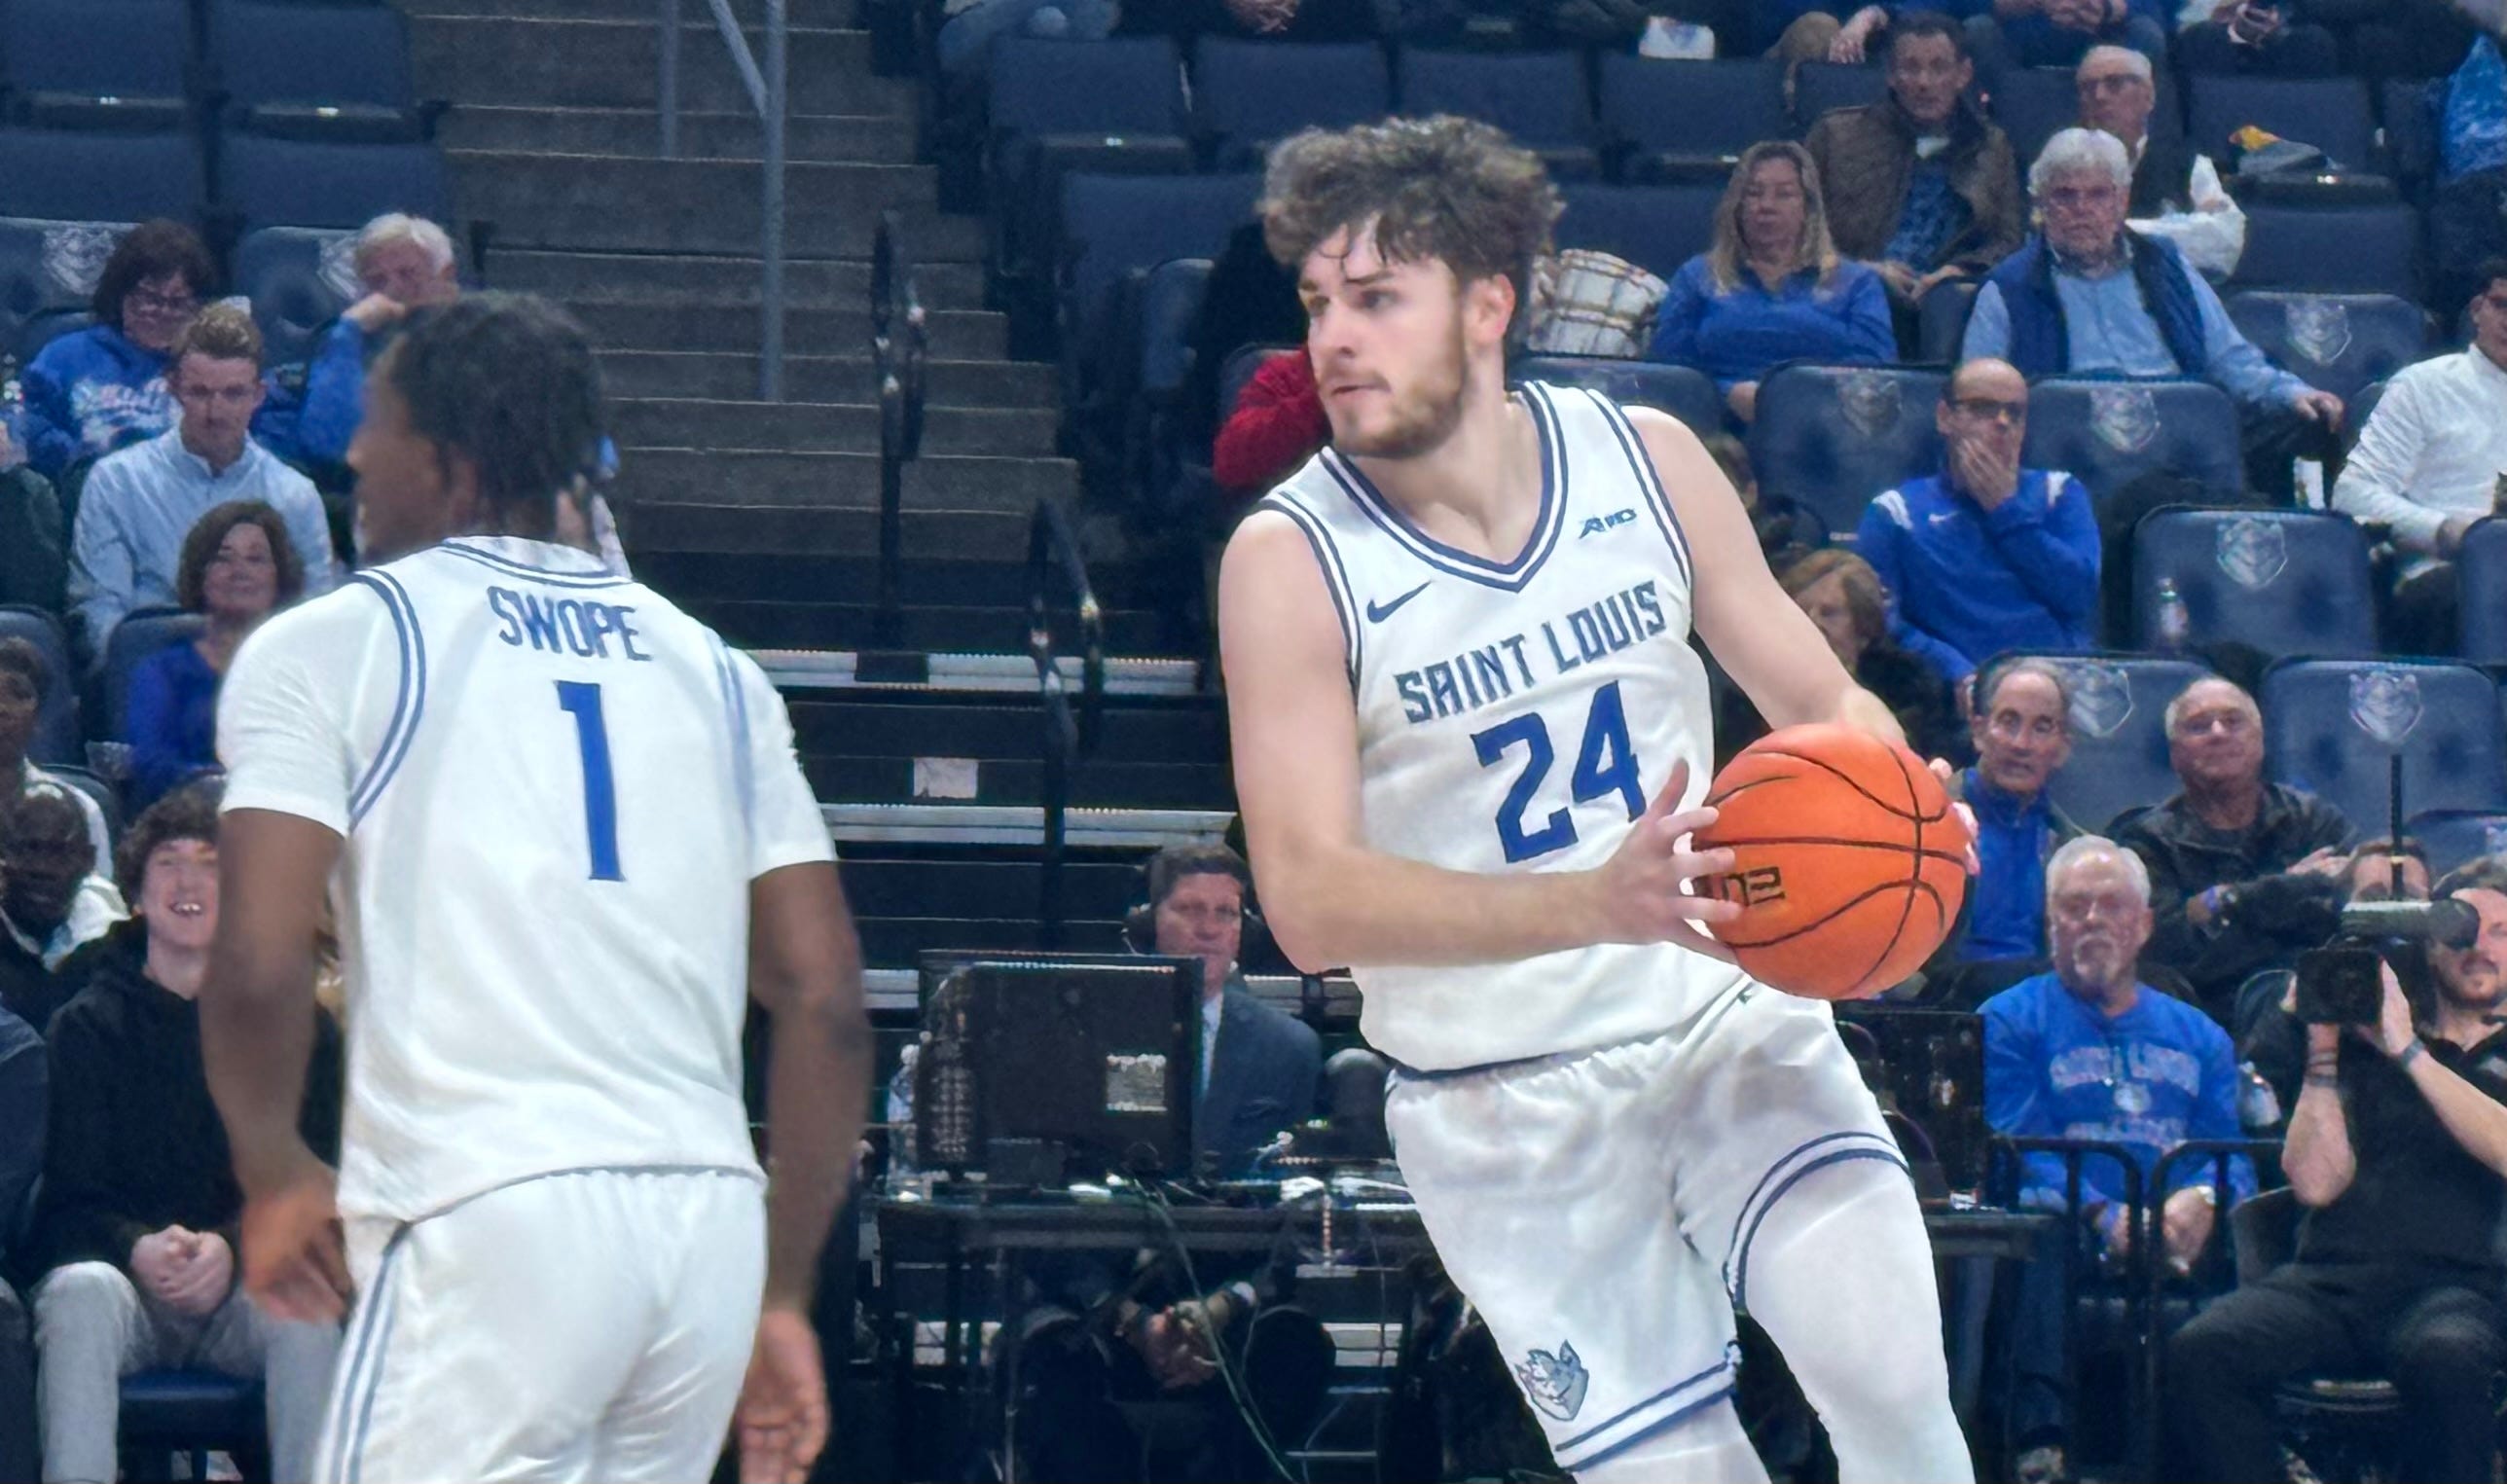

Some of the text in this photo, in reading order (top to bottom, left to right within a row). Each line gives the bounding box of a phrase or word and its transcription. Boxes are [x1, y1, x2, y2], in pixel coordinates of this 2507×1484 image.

[487, 586, 654, 662] SWOPE
[1394, 580, 1667, 724] SAINT LOUIS
[553, 679, 627, 883] 1
[1470, 680, 1647, 864] 24
